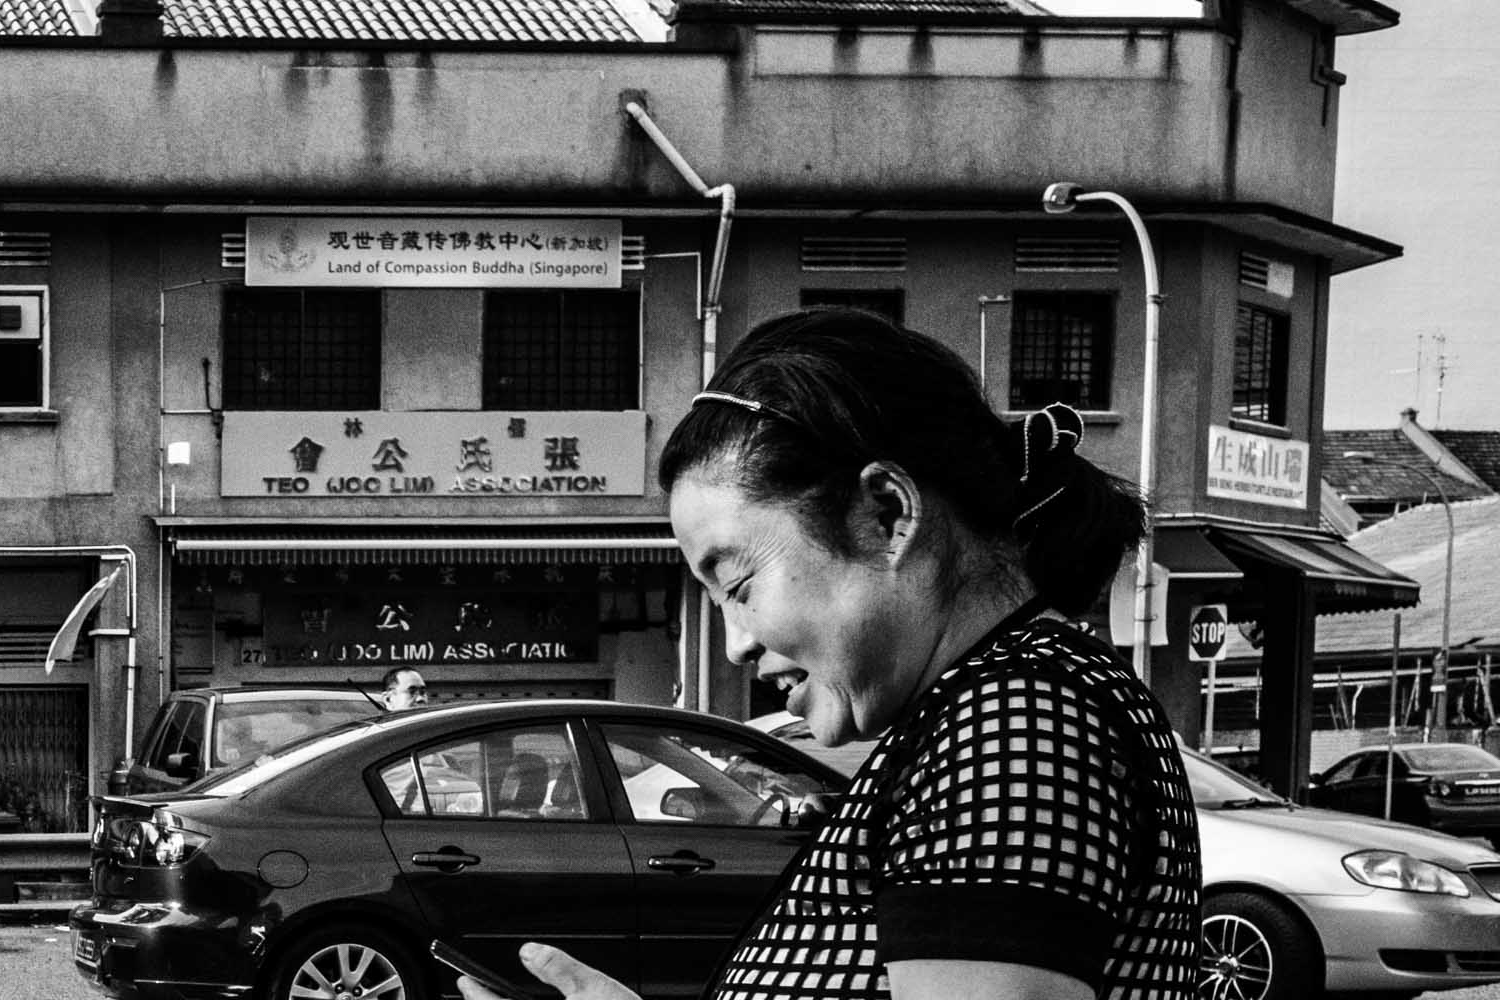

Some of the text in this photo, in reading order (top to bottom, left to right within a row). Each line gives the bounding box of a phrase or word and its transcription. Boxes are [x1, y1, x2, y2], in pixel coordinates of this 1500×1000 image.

[327, 261, 609, 277] Land of Compassion Buddha (Singapore)
[262, 477, 310, 493] TEO
[390, 476, 435, 494] LIM)
[448, 475, 607, 494] ASSOCIATION
[1192, 620, 1225, 644] STOP
[390, 642, 435, 661] LIM)
